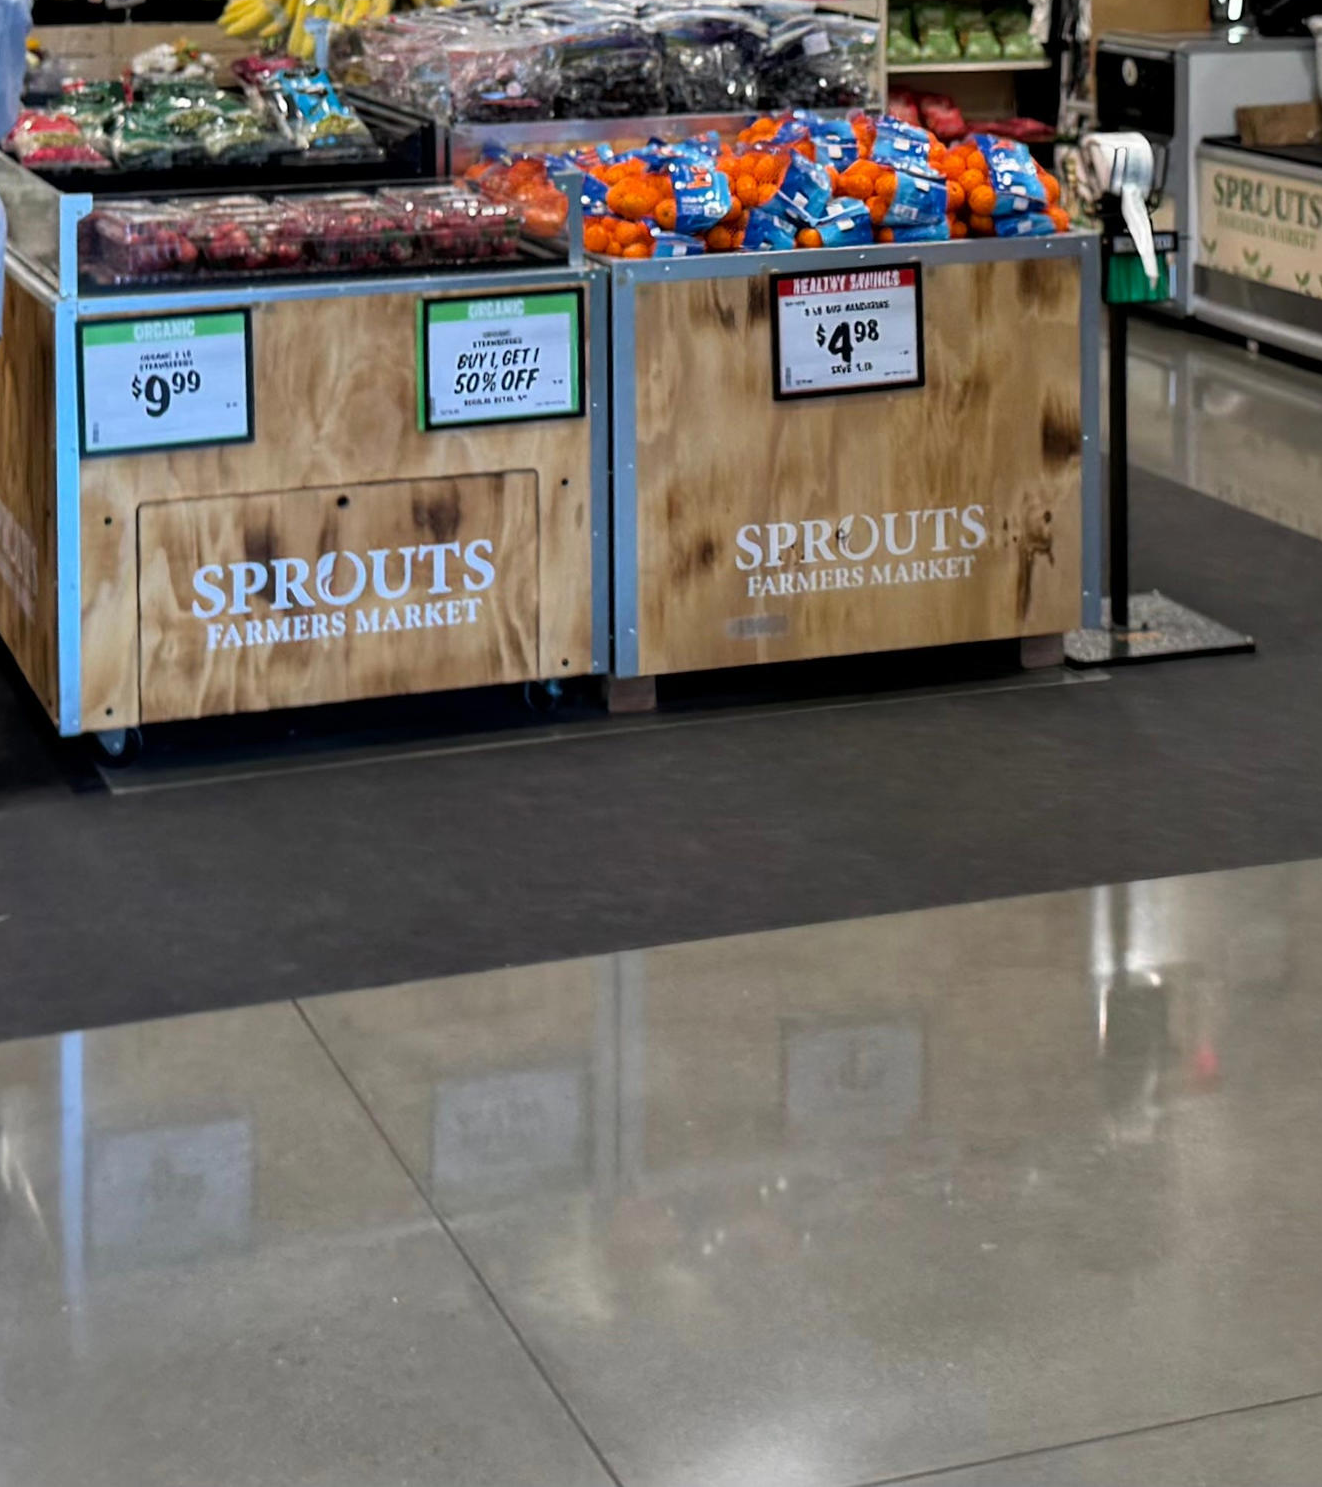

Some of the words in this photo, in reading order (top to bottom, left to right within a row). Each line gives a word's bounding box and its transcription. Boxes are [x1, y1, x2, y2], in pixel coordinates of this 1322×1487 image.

[792, 275, 846, 296] HEALTHY
[467, 299, 525, 320] ORGANIC
[134, 319, 196, 341] ORGANIC
[457, 352, 487, 370] BUY
[501, 348, 531, 367] GET
[454, 371, 498, 395] 50%
[501, 368, 541, 391] OFF
[735, 504, 987, 571] SPROUTS
[191, 538, 496, 619] SPROUTS
[747, 565, 865, 598] FARMERS
[869, 555, 977, 586] MARKET
[206, 611, 347, 652] FARMERS
[355, 598, 483, 634] MARKET
